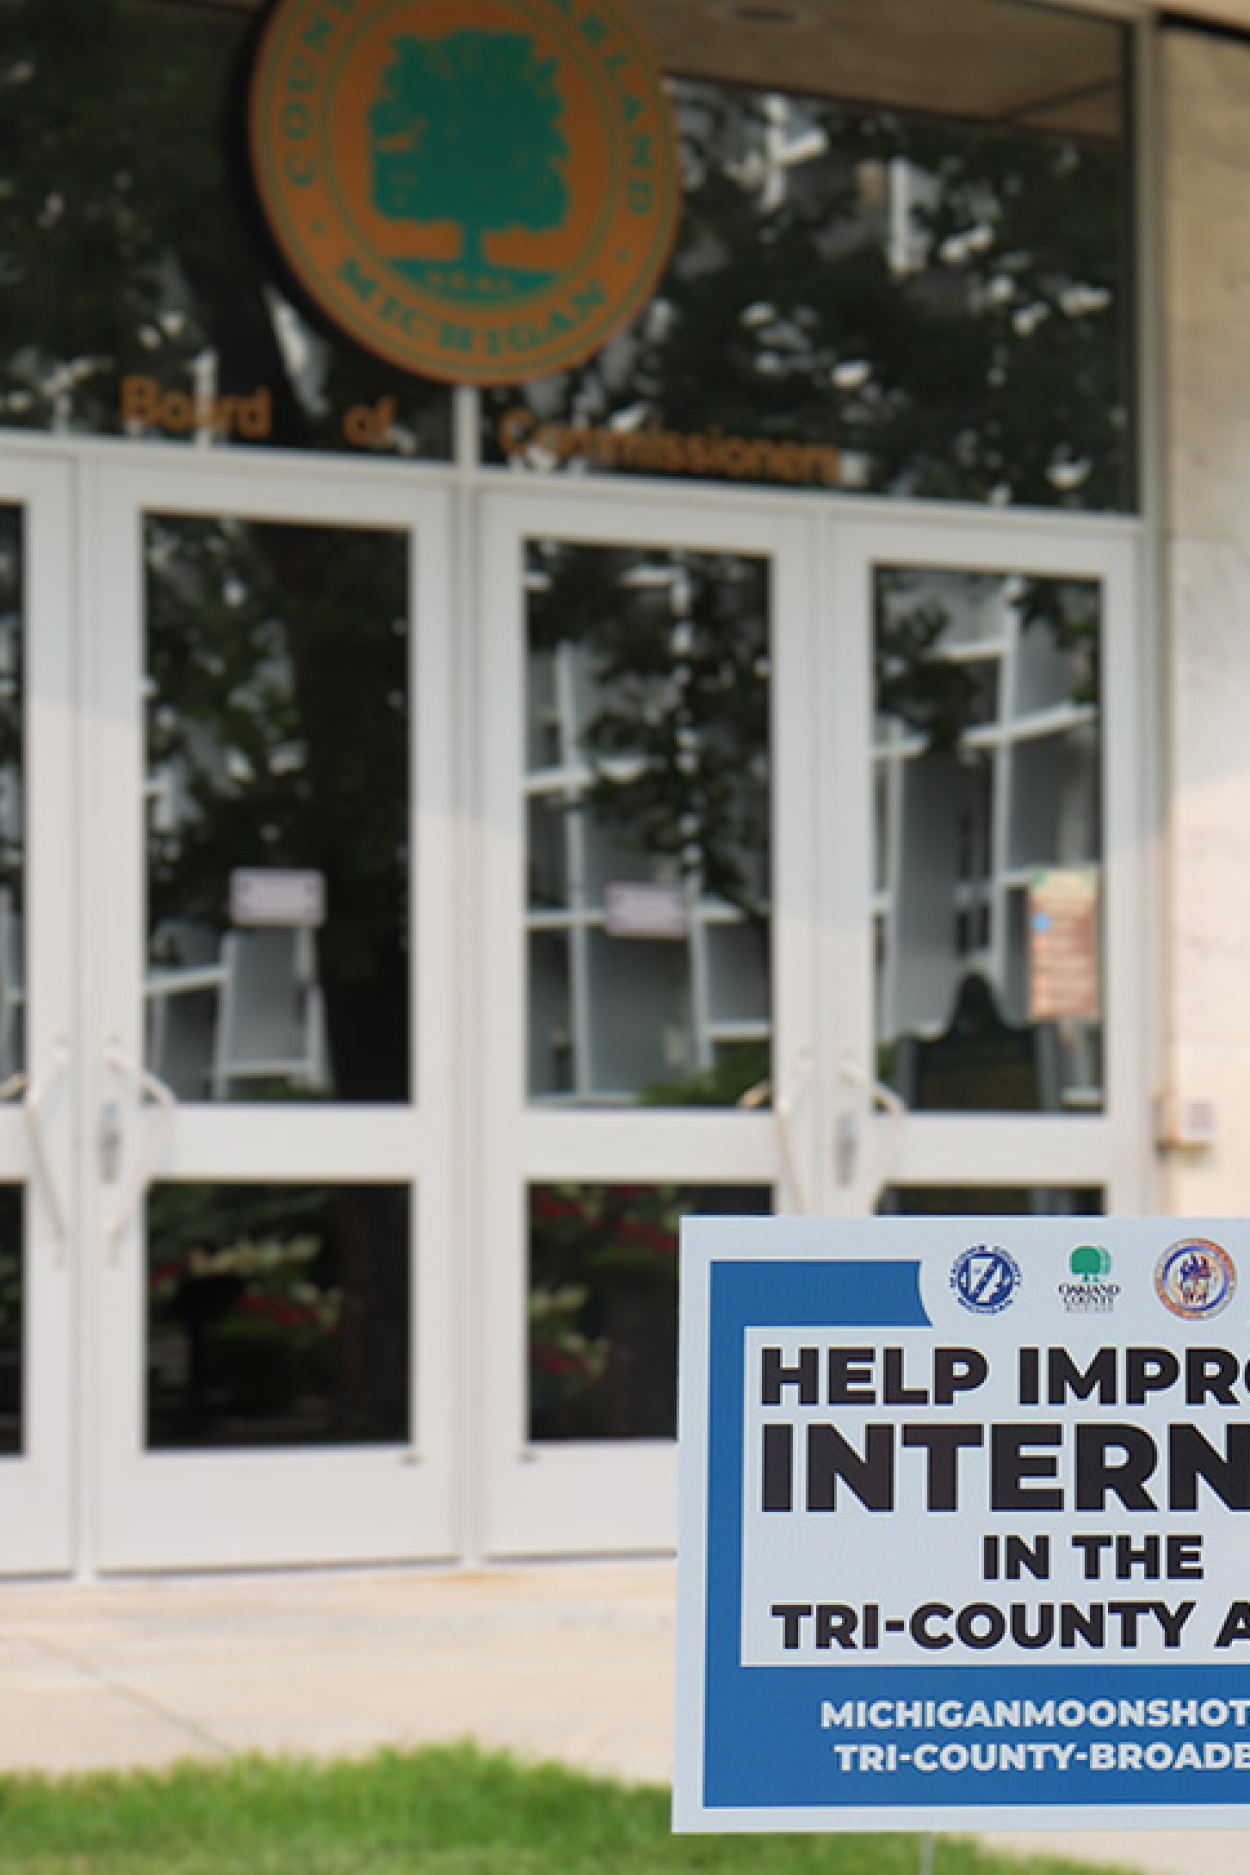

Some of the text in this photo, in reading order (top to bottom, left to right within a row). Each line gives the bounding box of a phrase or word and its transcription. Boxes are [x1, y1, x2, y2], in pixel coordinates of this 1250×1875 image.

[281, 0, 656, 219] COUN AKLAND
[334, 256, 607, 357] MICHIGAN
[121, 374, 272, 440] Board
[762, 1347, 987, 1406] HELP
[984, 1535, 1203, 1579] IN THE
[772, 1602, 1196, 1649] TRI-COUNTY
